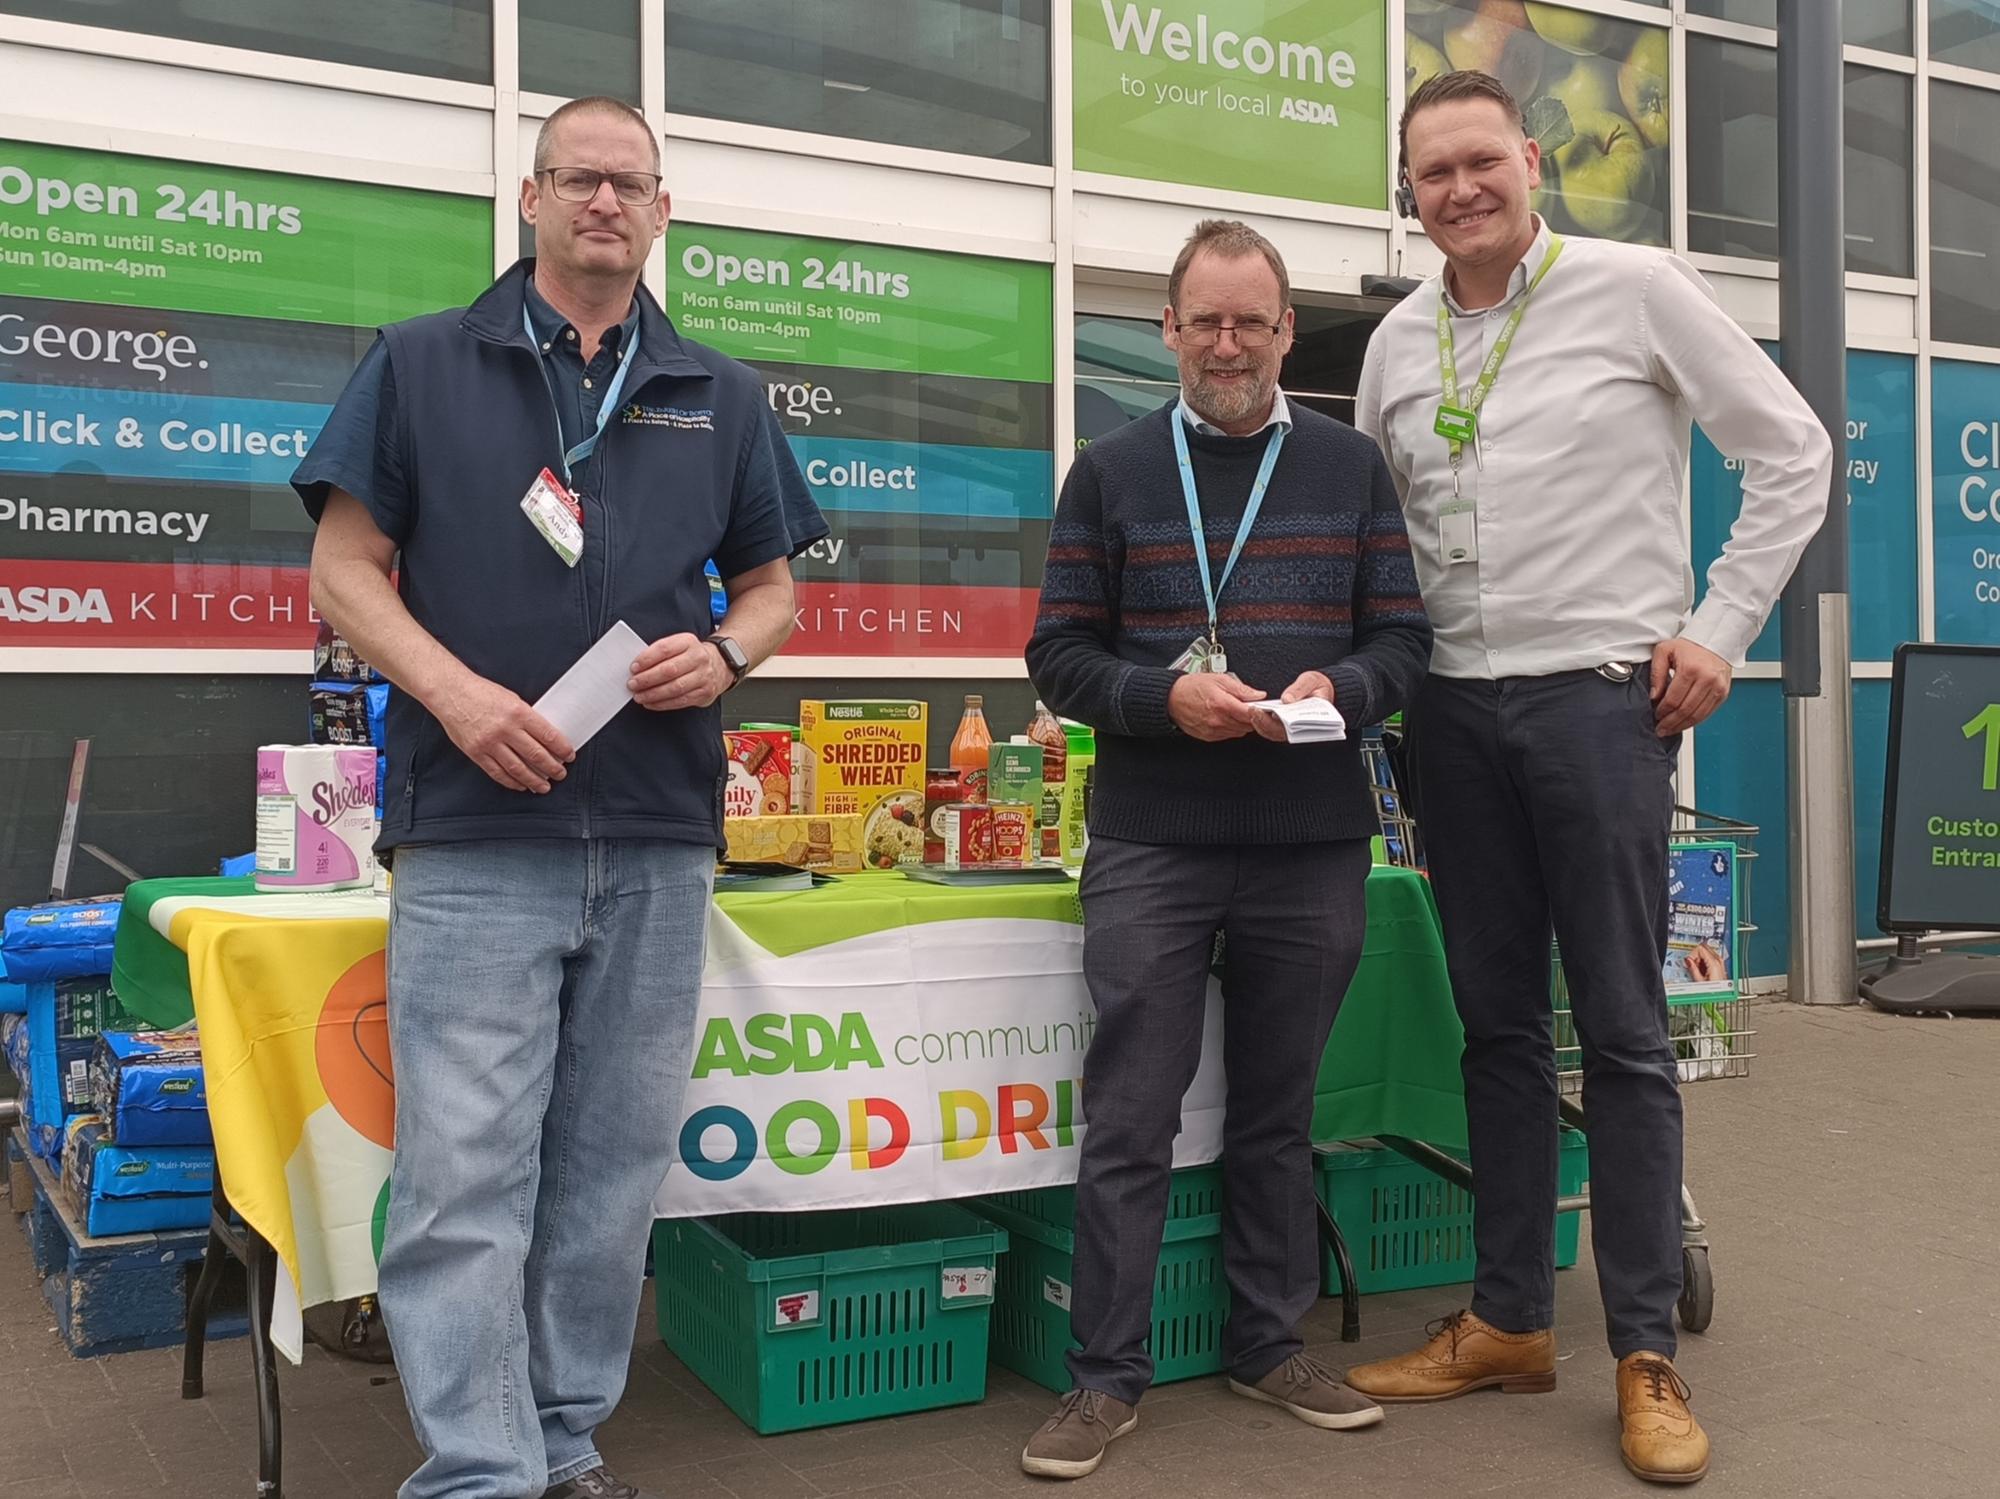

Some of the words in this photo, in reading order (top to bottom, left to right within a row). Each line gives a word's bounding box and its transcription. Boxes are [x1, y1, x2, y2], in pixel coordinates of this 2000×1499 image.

[1102, 1, 1356, 88] Welcome
[1121, 73, 1145, 97] to
[1154, 82, 1208, 105] your
[1217, 87, 1270, 116] local
[1279, 97, 1339, 127] ASDA
[0, 166, 139, 216] Open
[155, 184, 302, 235] 24hrs
[46, 226, 97, 247] 6am
[103, 233, 154, 252] until
[160, 238, 197, 257] Sat
[203, 242, 263, 263] 10pm
[41, 250, 167, 278] 10am-4pm
[682, 245, 790, 286] Open
[802, 258, 910, 298] 24hrs
[682, 291, 719, 309] Mon
[723, 296, 760, 314] 6am
[765, 301, 801, 317] until
[806, 304, 833, 320] Sat
[837, 306, 881, 325] 10pm
[682, 314, 715, 330] Sun
[719, 317, 811, 339] 10am-4pm
[1483, 350, 1500, 374] ASDA
[0, 410, 101, 446] Click
[115, 417, 144, 448] &
[160, 420, 308, 457] Collect
[806, 459, 916, 490] Collect
[327, 726, 353, 743] BOOST
[843, 726, 902, 741] ORIGINAL
[822, 743, 922, 764] SHREDDED
[840, 765, 906, 786] WHEAT
[824, 795, 849, 803] HIGH
[824, 804, 858, 814] FIBRE
[996, 811, 1023, 821] HEINZ
[995, 826, 1023, 835] HOOPS
[691, 1012, 885, 1079] ASDA
[938, 1079, 1088, 1162] DRI
